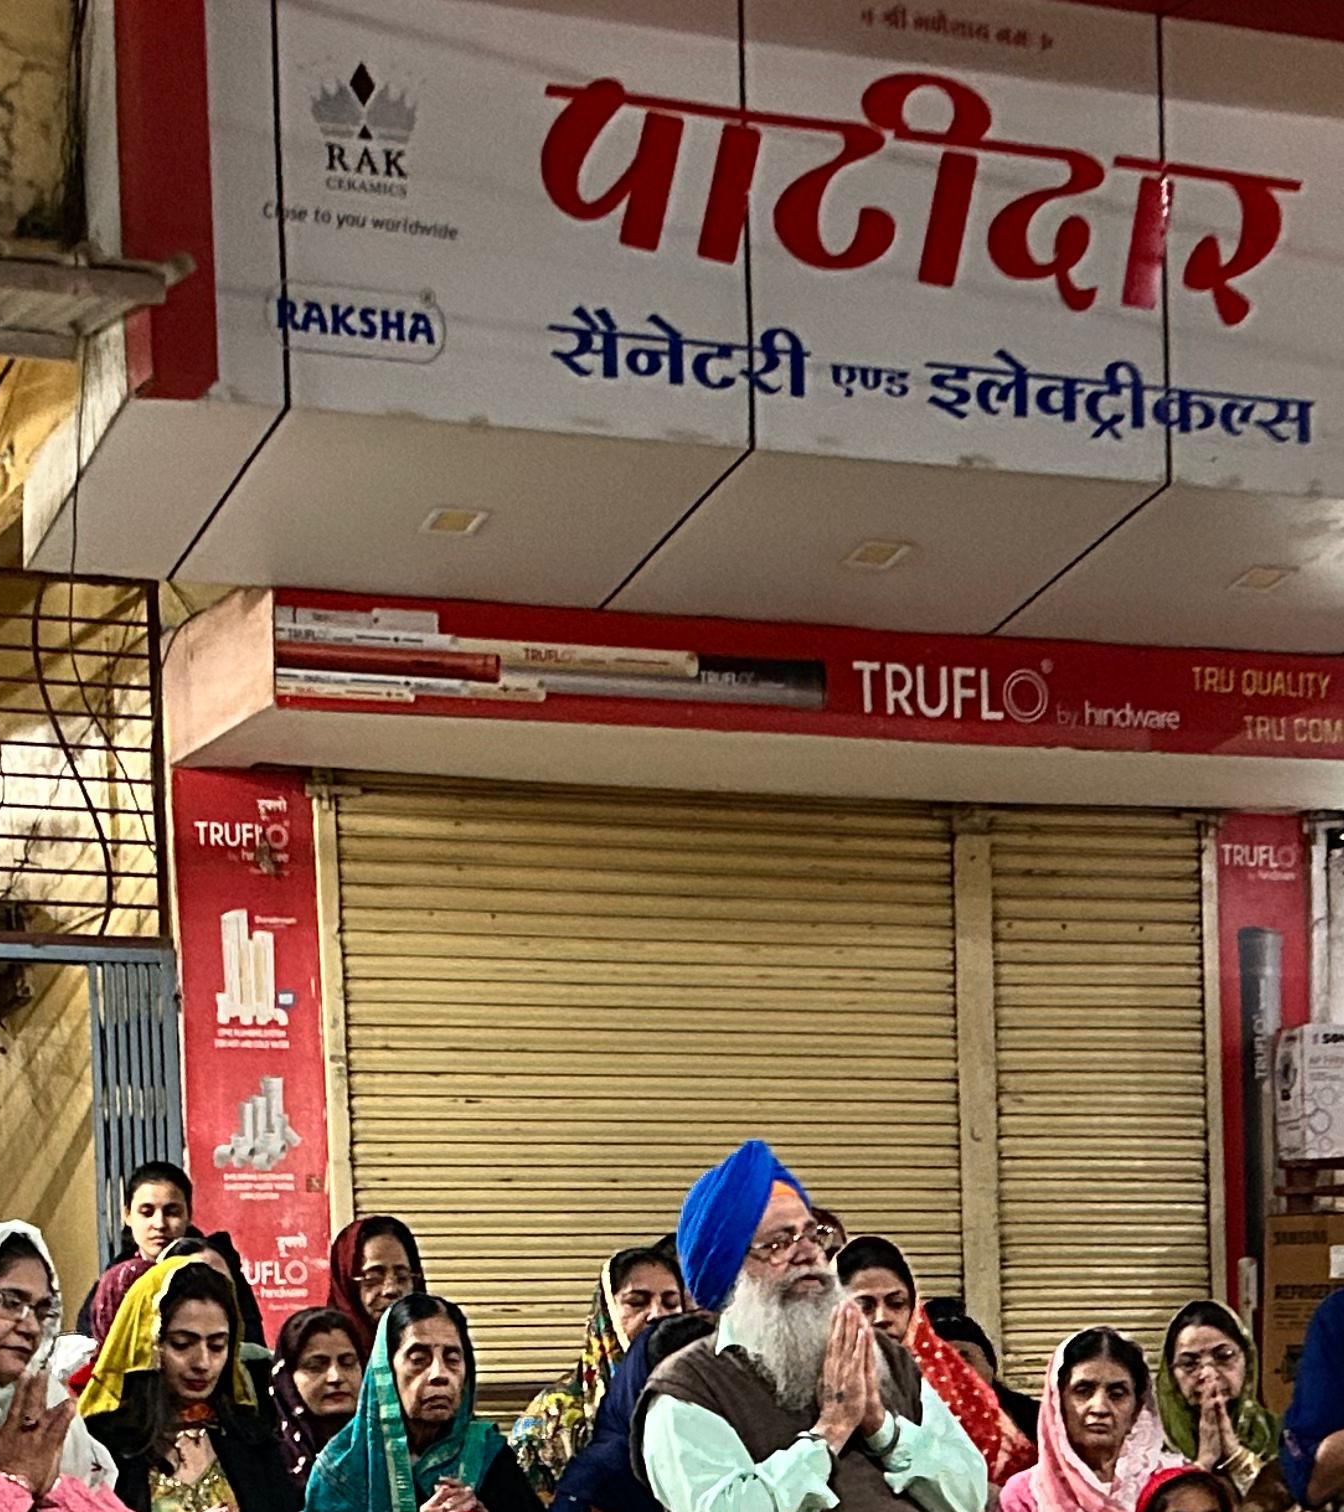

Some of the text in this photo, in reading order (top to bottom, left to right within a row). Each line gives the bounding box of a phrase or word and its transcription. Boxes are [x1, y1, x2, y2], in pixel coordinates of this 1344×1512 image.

[324, 142, 408, 180] RAK
[325, 176, 408, 199] CERAMICS
[540, 71, 1303, 327] पाटीदार
[314, 206, 332, 223] to
[336, 210, 367, 230] you
[371, 214, 459, 241] worldwide
[276, 298, 436, 346] RAKSHA
[546, 305, 1315, 445] सैनेटरी एण्ड इलेक्ट्रीकल्स
[852, 661, 1049, 723] TRUFLO
[1084, 701, 1181, 731] hindware
[1192, 665, 1331, 700] TRU QUALITY
[1244, 714, 1286, 743] TRU
[1221, 842, 1298, 869] TRUFLO
